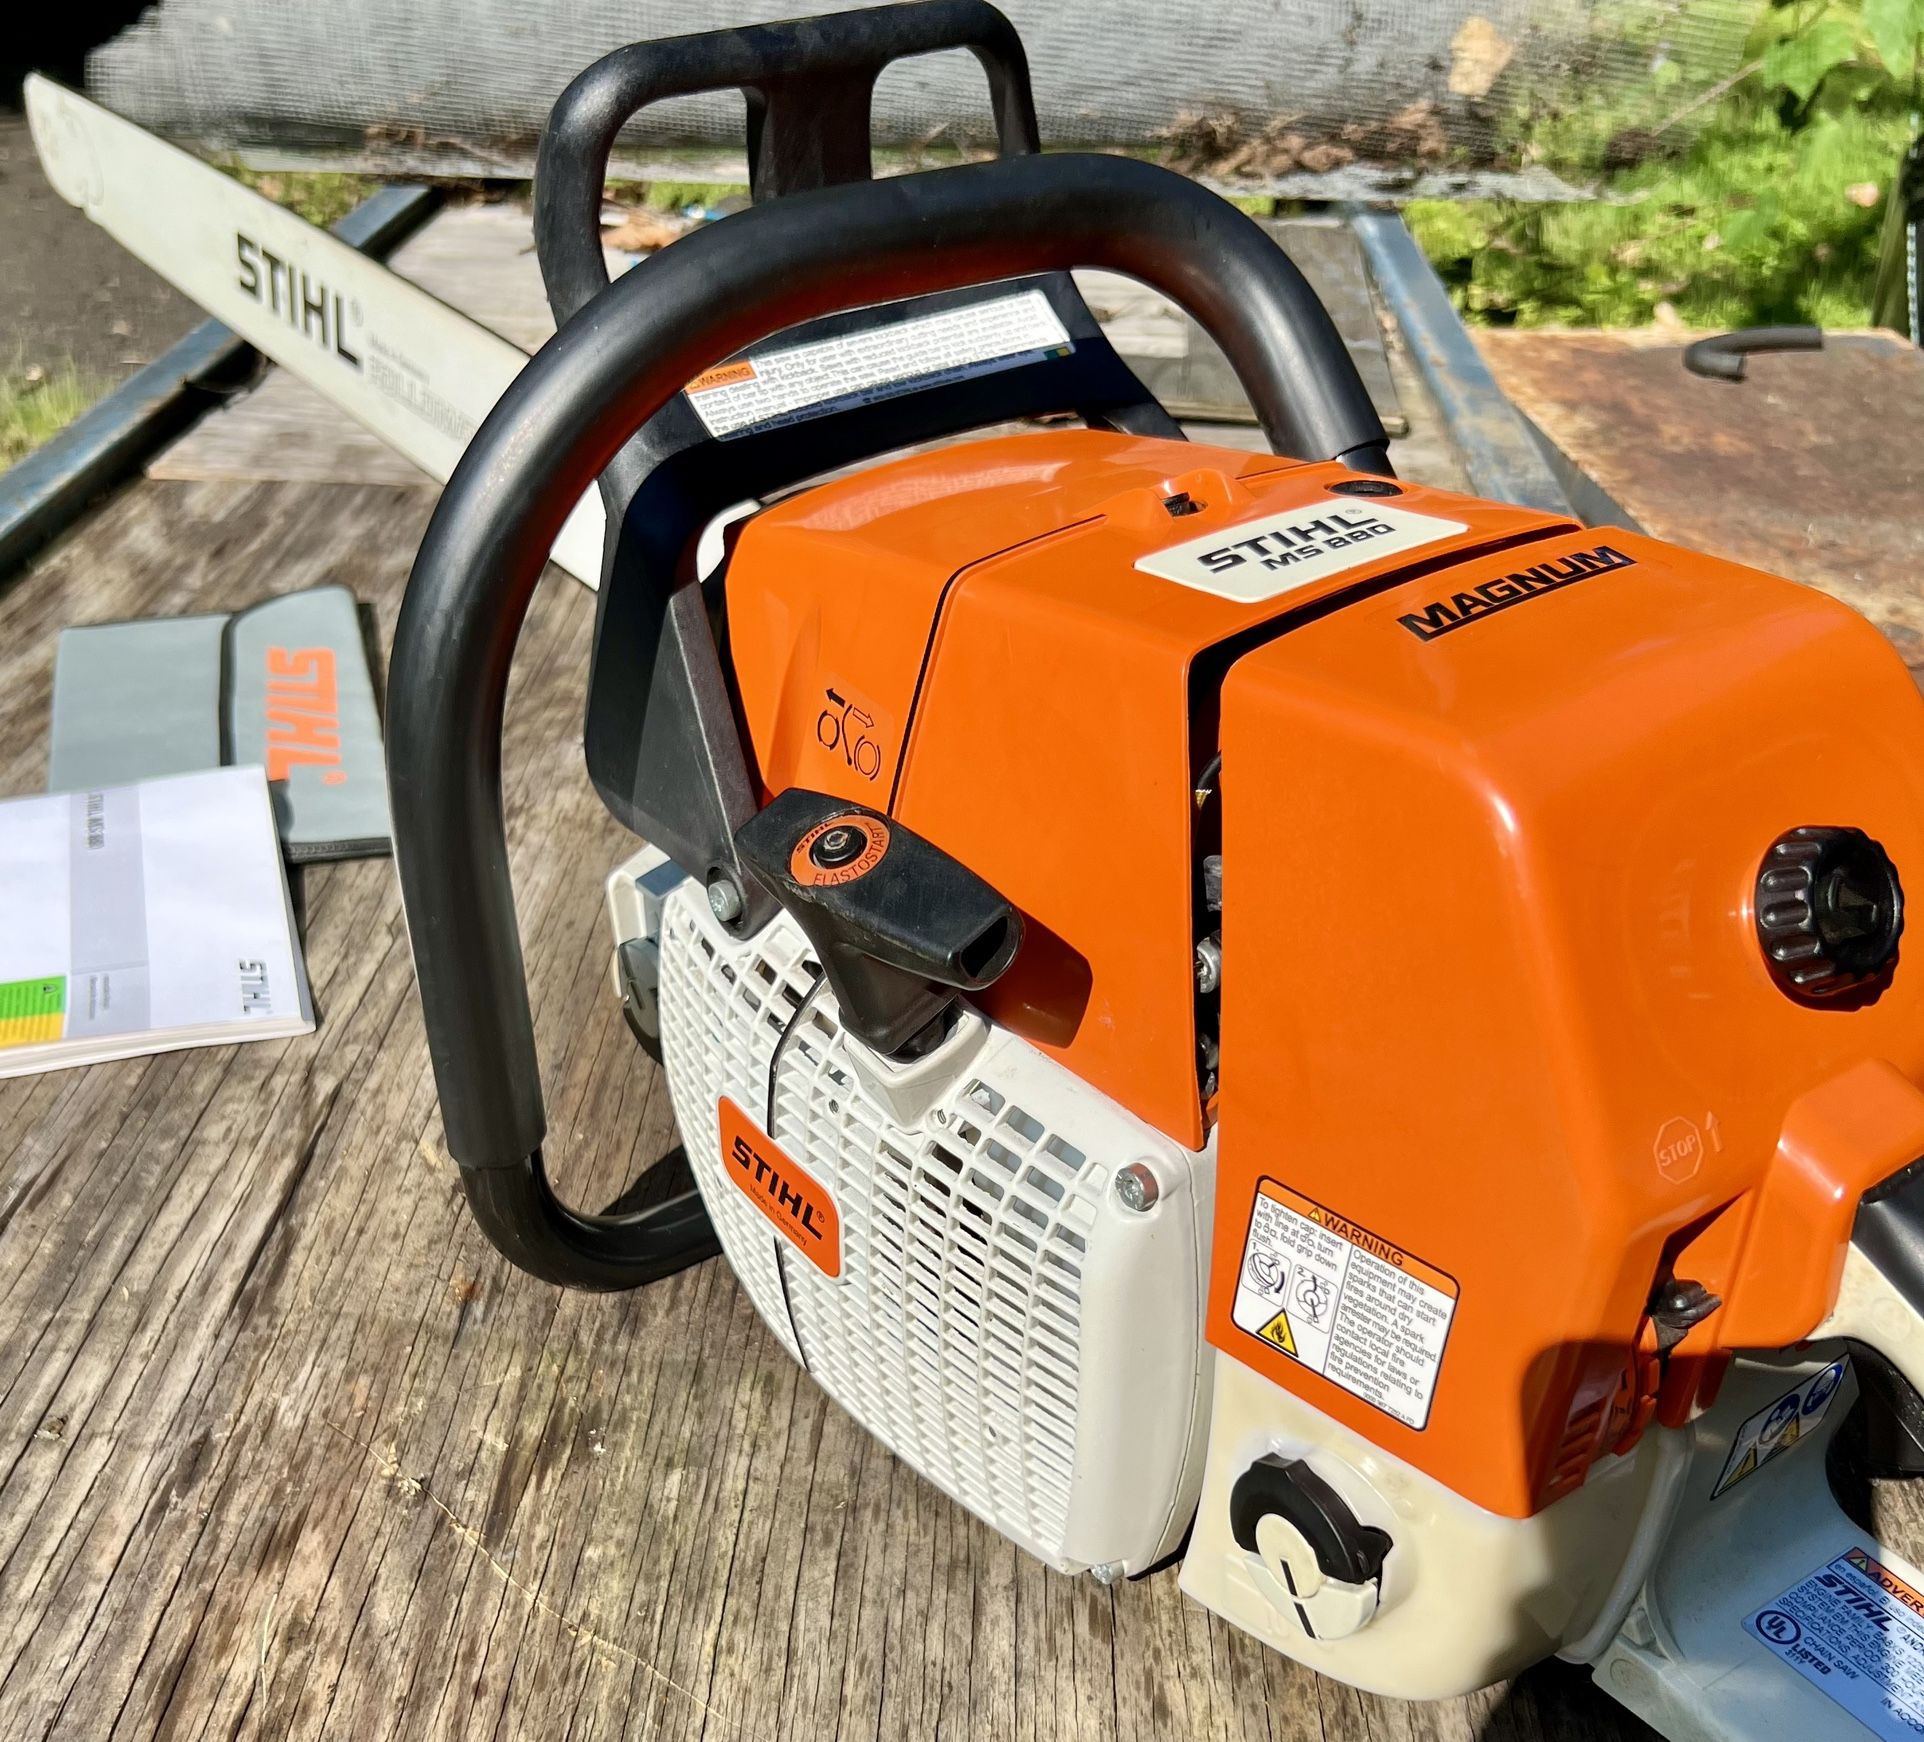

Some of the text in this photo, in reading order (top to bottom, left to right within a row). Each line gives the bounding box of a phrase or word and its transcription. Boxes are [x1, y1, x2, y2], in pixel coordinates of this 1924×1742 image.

[237, 232, 360, 367] STIHL
[698, 367, 749, 385] WARNING
[1197, 515, 1379, 574] STIHL
[1261, 524, 1396, 571] MS 880
[1398, 546, 1634, 640] MAGNUM
[266, 645, 342, 782] STIHL
[795, 821, 833, 854] STIHL
[813, 822, 886, 887] ELASTOSTART
[239, 959, 272, 1015] STIHL
[1658, 1134, 1696, 1167] STOP
[732, 1135, 823, 1240] STIHL
[750, 1183, 808, 1246] Made in Germany
[1252, 1228, 1272, 1246] flush.
[1256, 1209, 1333, 1256] with line at turn
[1259, 1196, 1342, 1250] To tighten cap: insert
[1324, 1214, 1402, 1265] WARNING
[1254, 1218, 1337, 1270] to fold grip down
[1350, 1261, 1446, 1319] equipment may create
[1353, 1249, 1424, 1295] Operation of this
[1340, 1303, 1371, 1324] arrester
[1371, 1320, 1390, 1336] may
[1390, 1329, 1401, 1341] be
[1343, 1293, 1423, 1343] vegetation. A spark
[1345, 1280, 1413, 1325] fires around dry
[1348, 1272, 1436, 1326] sparks that can start
[1334, 1333, 1419, 1385] agencies for laws or
[1336, 1323, 1405, 1367] contact local fire
[1339, 1311, 1424, 1366] The operator should
[1328, 1363, 1383, 1399] requirements.
[1329, 1350, 1389, 1391] fire prevention
[1332, 1343, 1423, 1399] regulations relating to
[1805, 1579, 1840, 1606] ENGINE
[1815, 1575, 1891, 1631] STIHL
[1834, 1563, 1846, 1572] en
[1878, 1595, 1890, 1605] El
[1906, 1617, 1923, 1633] inde
[1868, 1572, 1924, 1614] ADVER
[1766, 1615, 1785, 1638] UL
[1788, 1591, 1845, 1636] COMPLIANCE
[1880, 1662, 1899, 1677] 300
[1831, 1611, 1849, 1624] EM
[1847, 1623, 1870, 1641] THIS
[1868, 1640, 1905, 1668] ENGINE
[1902, 1634, 1924, 1657] AND
[1791, 1643, 1830, 1673] LISTED
[1803, 1636, 1858, 1678] CHAIN SAW
[1852, 1654, 1912, 1697] ADJUSTMENT
[1881, 1697, 1894, 1708] IN
